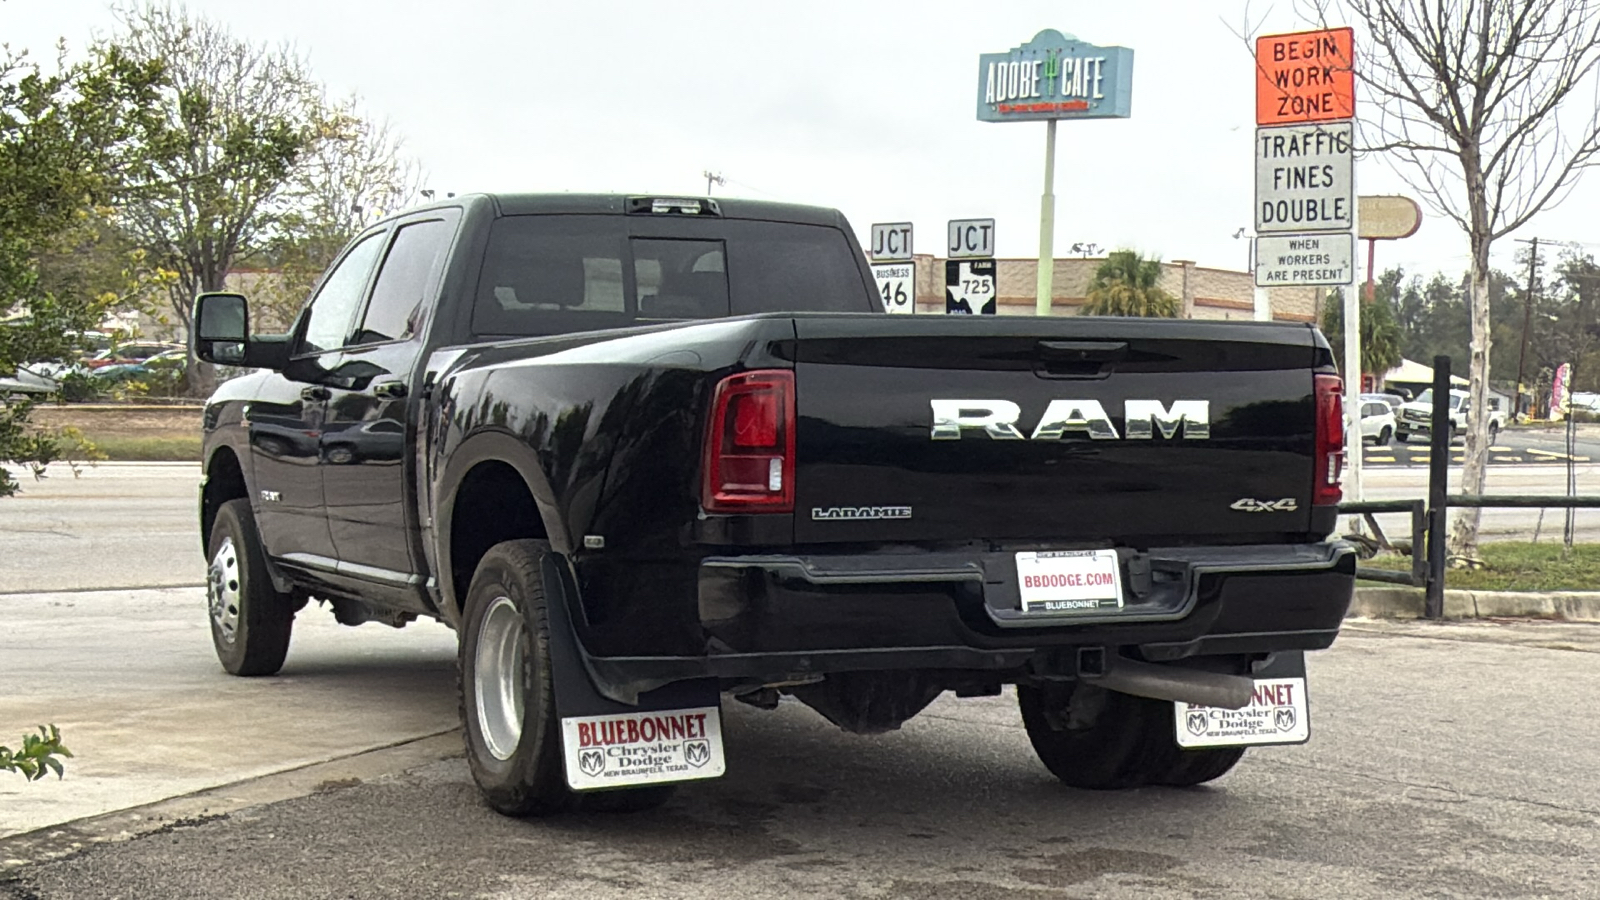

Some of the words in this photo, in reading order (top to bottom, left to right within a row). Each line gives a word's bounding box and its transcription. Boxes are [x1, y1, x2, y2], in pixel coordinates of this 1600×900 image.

[1273, 37, 1337, 62] BEGIN
[985, 60, 1043, 104] ADOBE
[1061, 57, 1106, 99] CAFE
[1275, 66, 1335, 88] WORK
[1277, 93, 1334, 116] ZONE
[1261, 131, 1348, 159] TRAFFIC
[1273, 165, 1334, 190] FINES
[1262, 198, 1346, 223] DOUBLE
[874, 228, 911, 255] JCT
[950, 225, 992, 253] JCT
[1289, 239, 1320, 250] WHEN
[1278, 254, 1331, 265] WORKERS
[876, 268, 910, 279] BUSINESS
[1266, 270, 1289, 281] ARE
[1293, 268, 1343, 280] PRESENT
[881, 281, 908, 306] 46
[962, 279, 991, 294] 725
[930, 399, 1210, 440] RAM
[812, 506, 912, 520] LARAMIE
[1024, 573, 1114, 588] BBDODGE.COM
[1045, 600, 1100, 610] BLUEBONNET
[1209, 708, 1272, 721] Chrysler
[578, 713, 707, 748] BLUEBONNET
[1219, 719, 1265, 729] Dodge
[606, 742, 681, 758] Chrysler
[618, 754, 673, 768] Dodge
[666, 764, 689, 772] TEXAS
